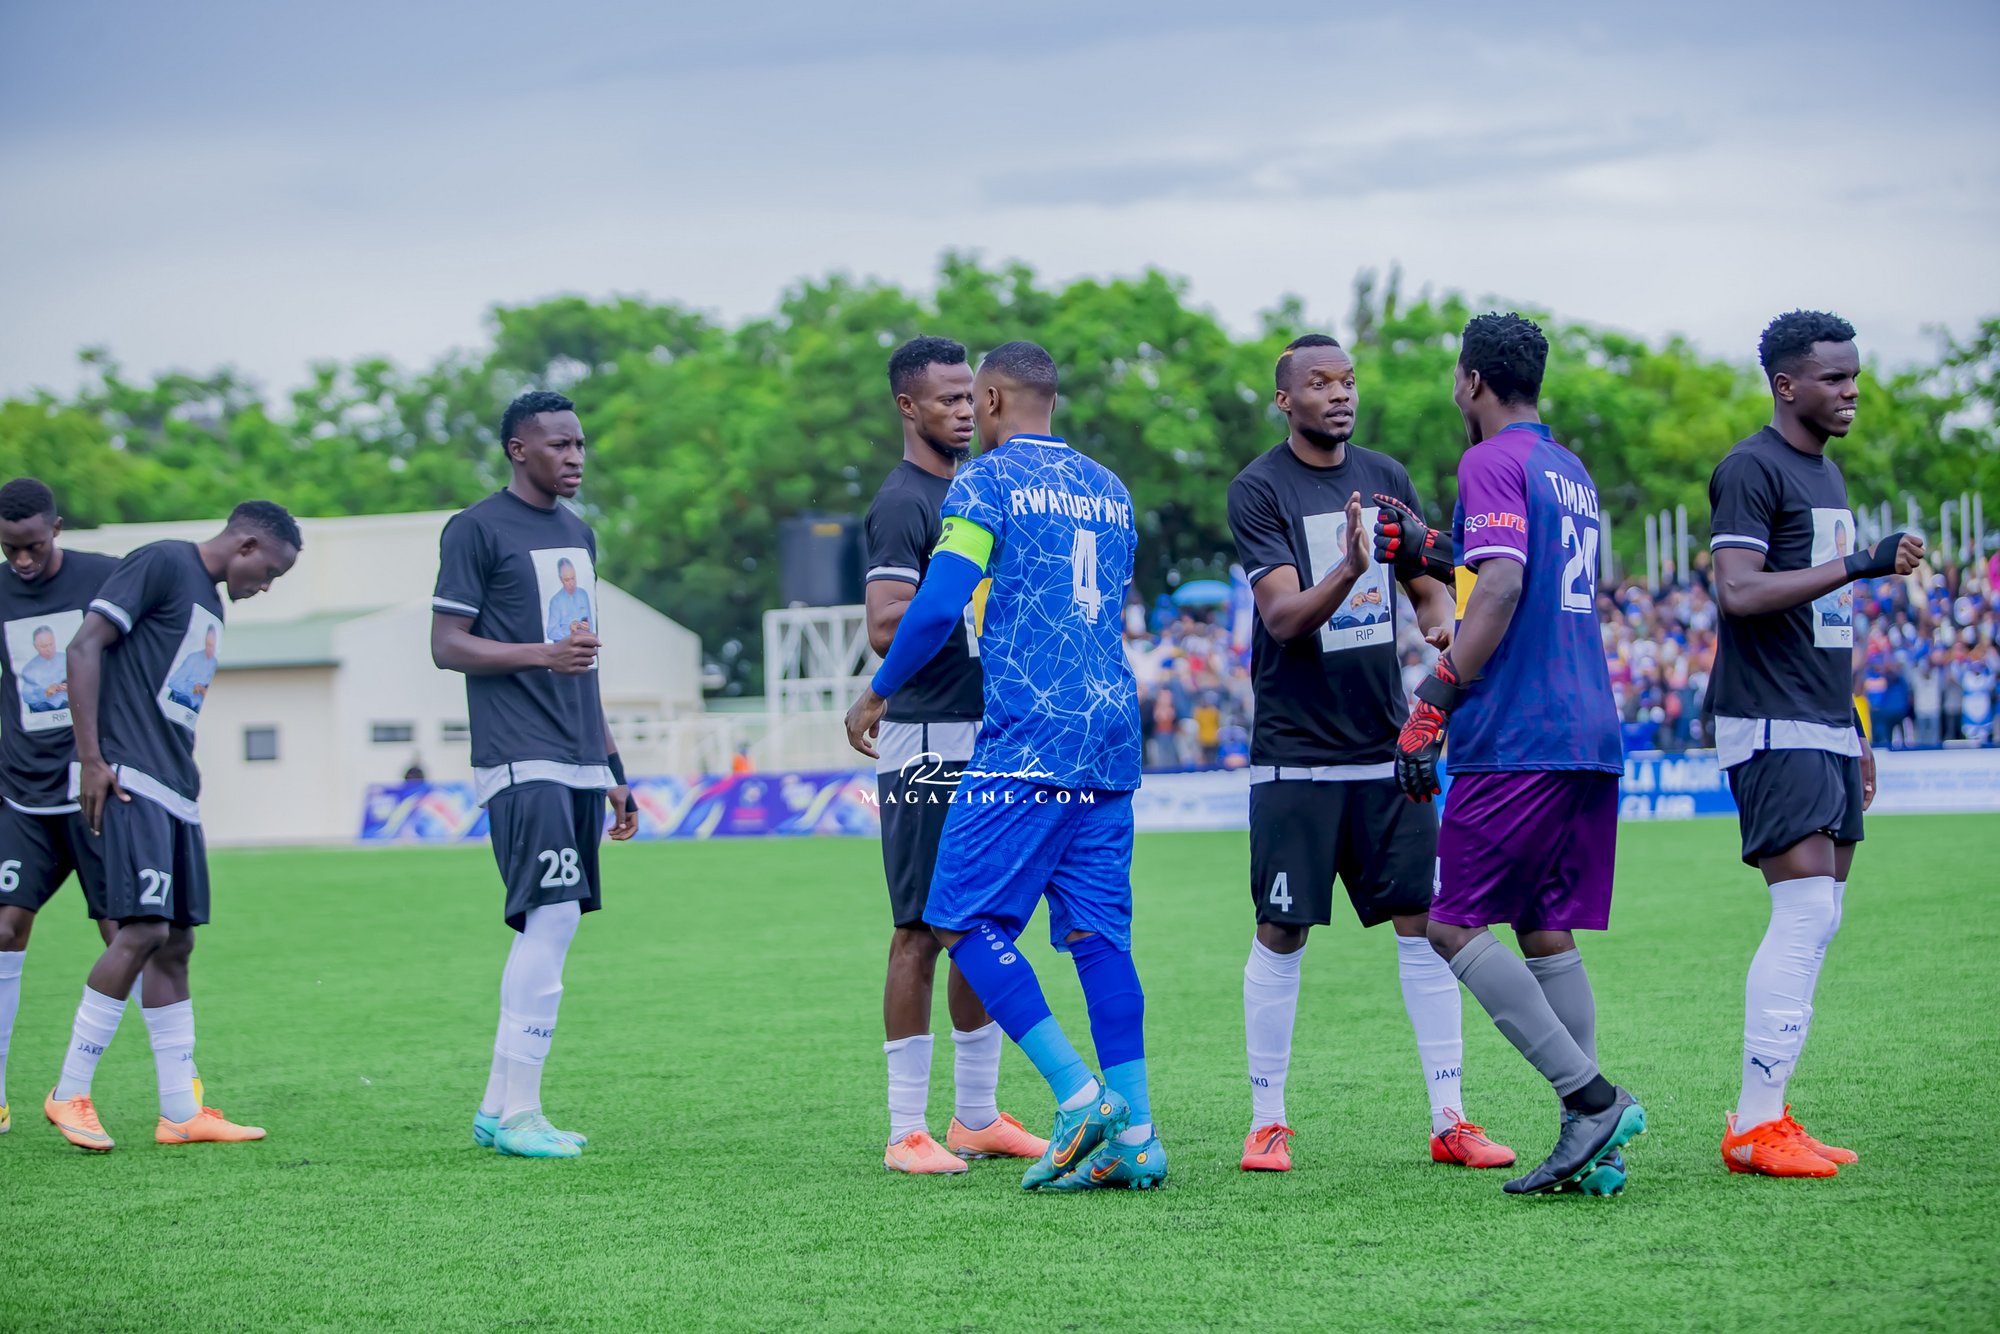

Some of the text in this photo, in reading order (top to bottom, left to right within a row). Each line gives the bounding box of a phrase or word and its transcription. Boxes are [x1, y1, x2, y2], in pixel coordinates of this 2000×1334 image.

[1073, 529, 1101, 625] 4
[1355, 628, 1375, 642] RIP
[52, 711, 68, 722] RIP
[138, 868, 172, 907] 27
[537, 847, 581, 889] 28
[1269, 872, 1293, 912] 4
[1434, 1066, 1462, 1081] JAKO
